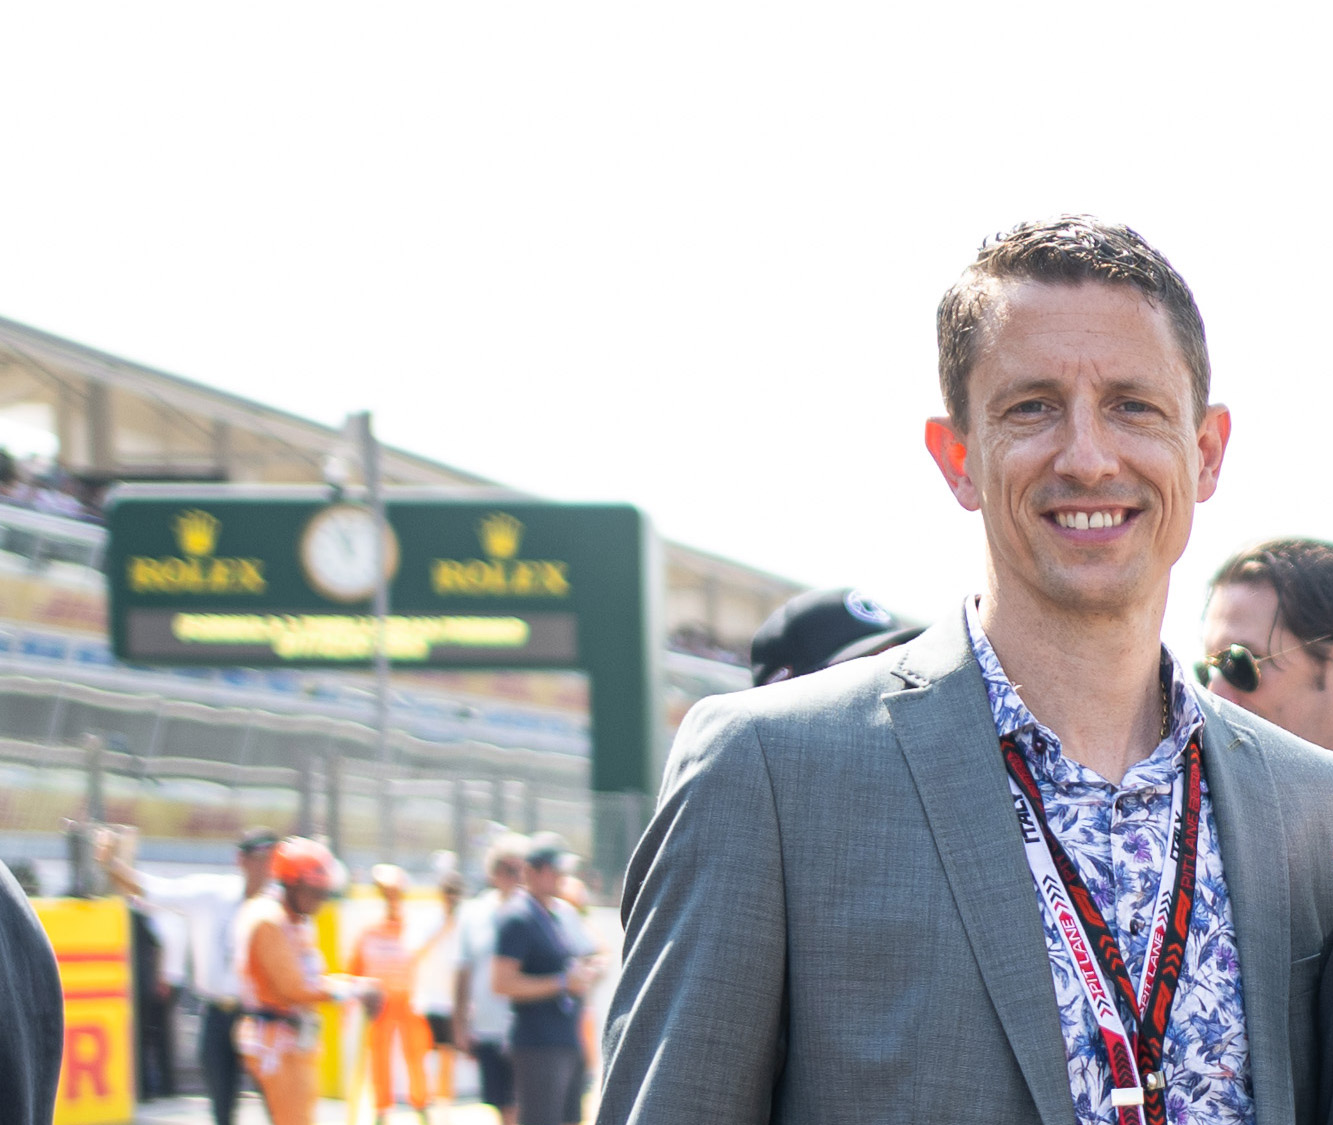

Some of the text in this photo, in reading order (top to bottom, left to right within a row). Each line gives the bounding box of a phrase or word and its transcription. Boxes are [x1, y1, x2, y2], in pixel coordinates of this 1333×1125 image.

[127, 556, 267, 594] ROLEX
[431, 557, 571, 596] ROLEX
[1061, 916, 1104, 998] PIT LANE
[1140, 931, 1164, 1008] PIT LANE
